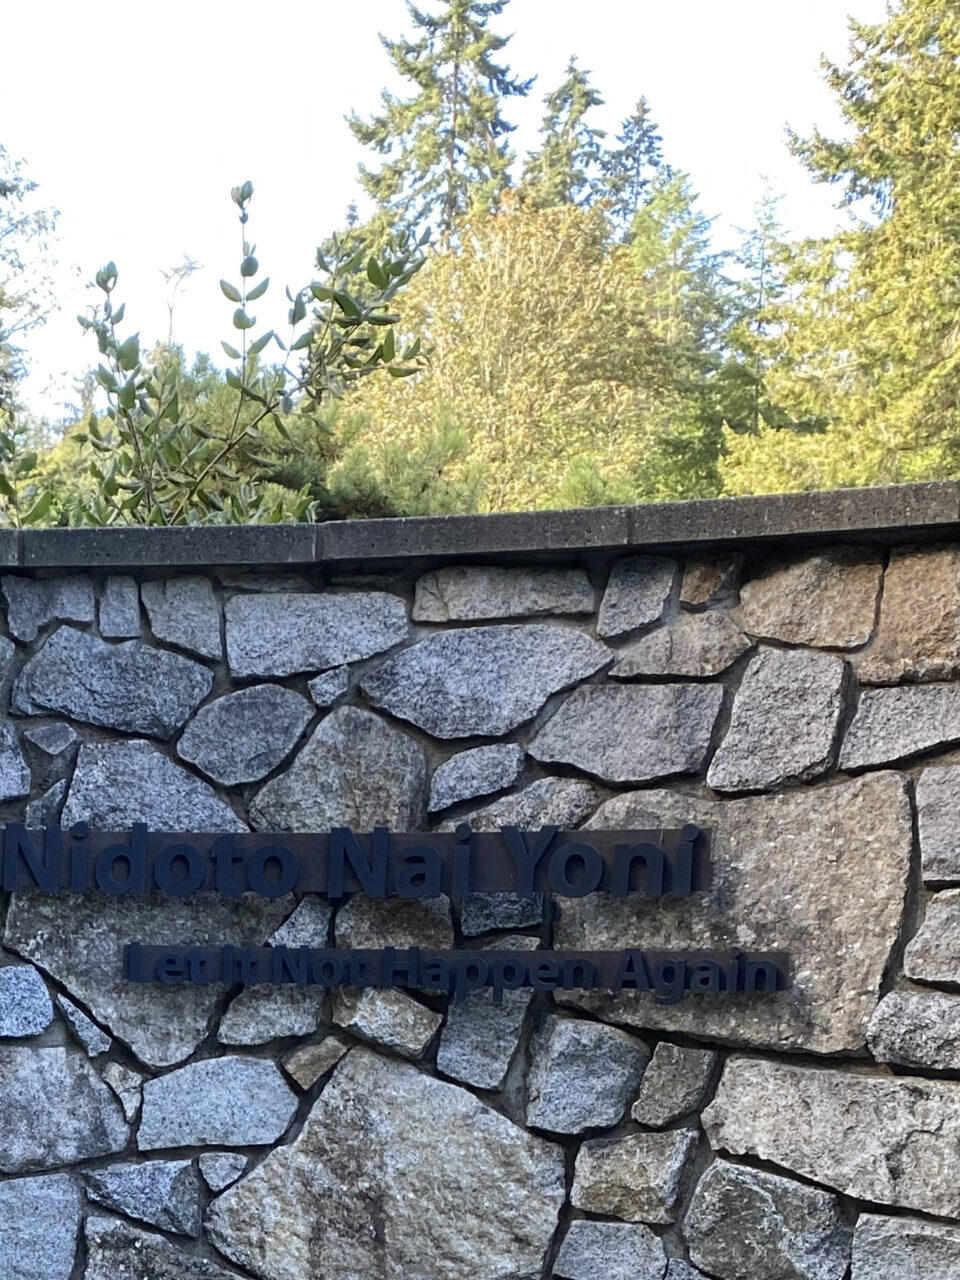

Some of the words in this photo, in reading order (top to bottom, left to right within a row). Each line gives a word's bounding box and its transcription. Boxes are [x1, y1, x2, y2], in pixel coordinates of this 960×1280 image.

[1, 822, 300, 897] Nidoto
[326, 824, 472, 898] Nai
[500, 823, 700, 898] Yoni
[128, 941, 206, 984] Let
[221, 944, 257, 985] It
[271, 944, 367, 986] Not
[383, 946, 595, 1002] Happen
[614, 947, 781, 1004] Again
